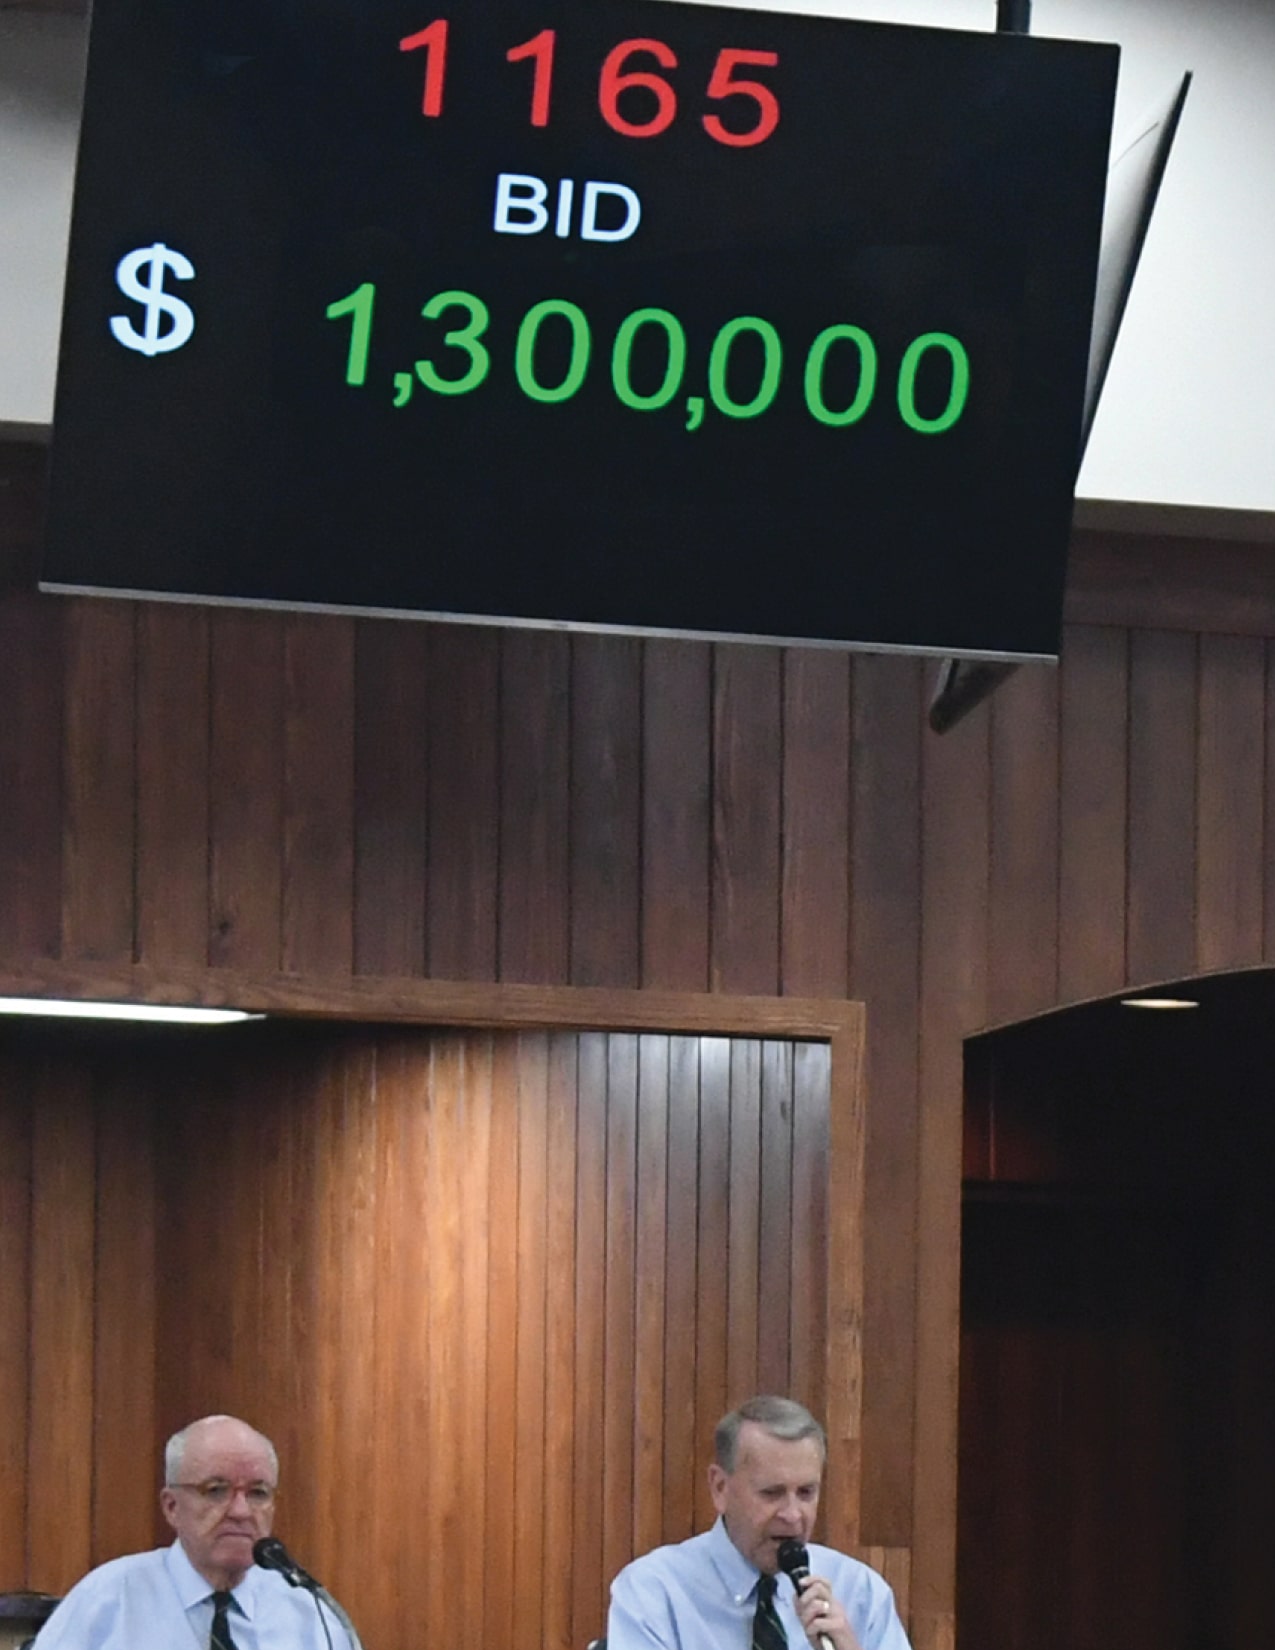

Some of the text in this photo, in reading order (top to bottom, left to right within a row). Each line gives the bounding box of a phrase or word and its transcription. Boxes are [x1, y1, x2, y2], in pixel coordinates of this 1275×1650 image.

[399, 19, 779, 147] 1165
[493, 173, 641, 242] BID
[109, 242, 970, 434] $ 1,300,000
